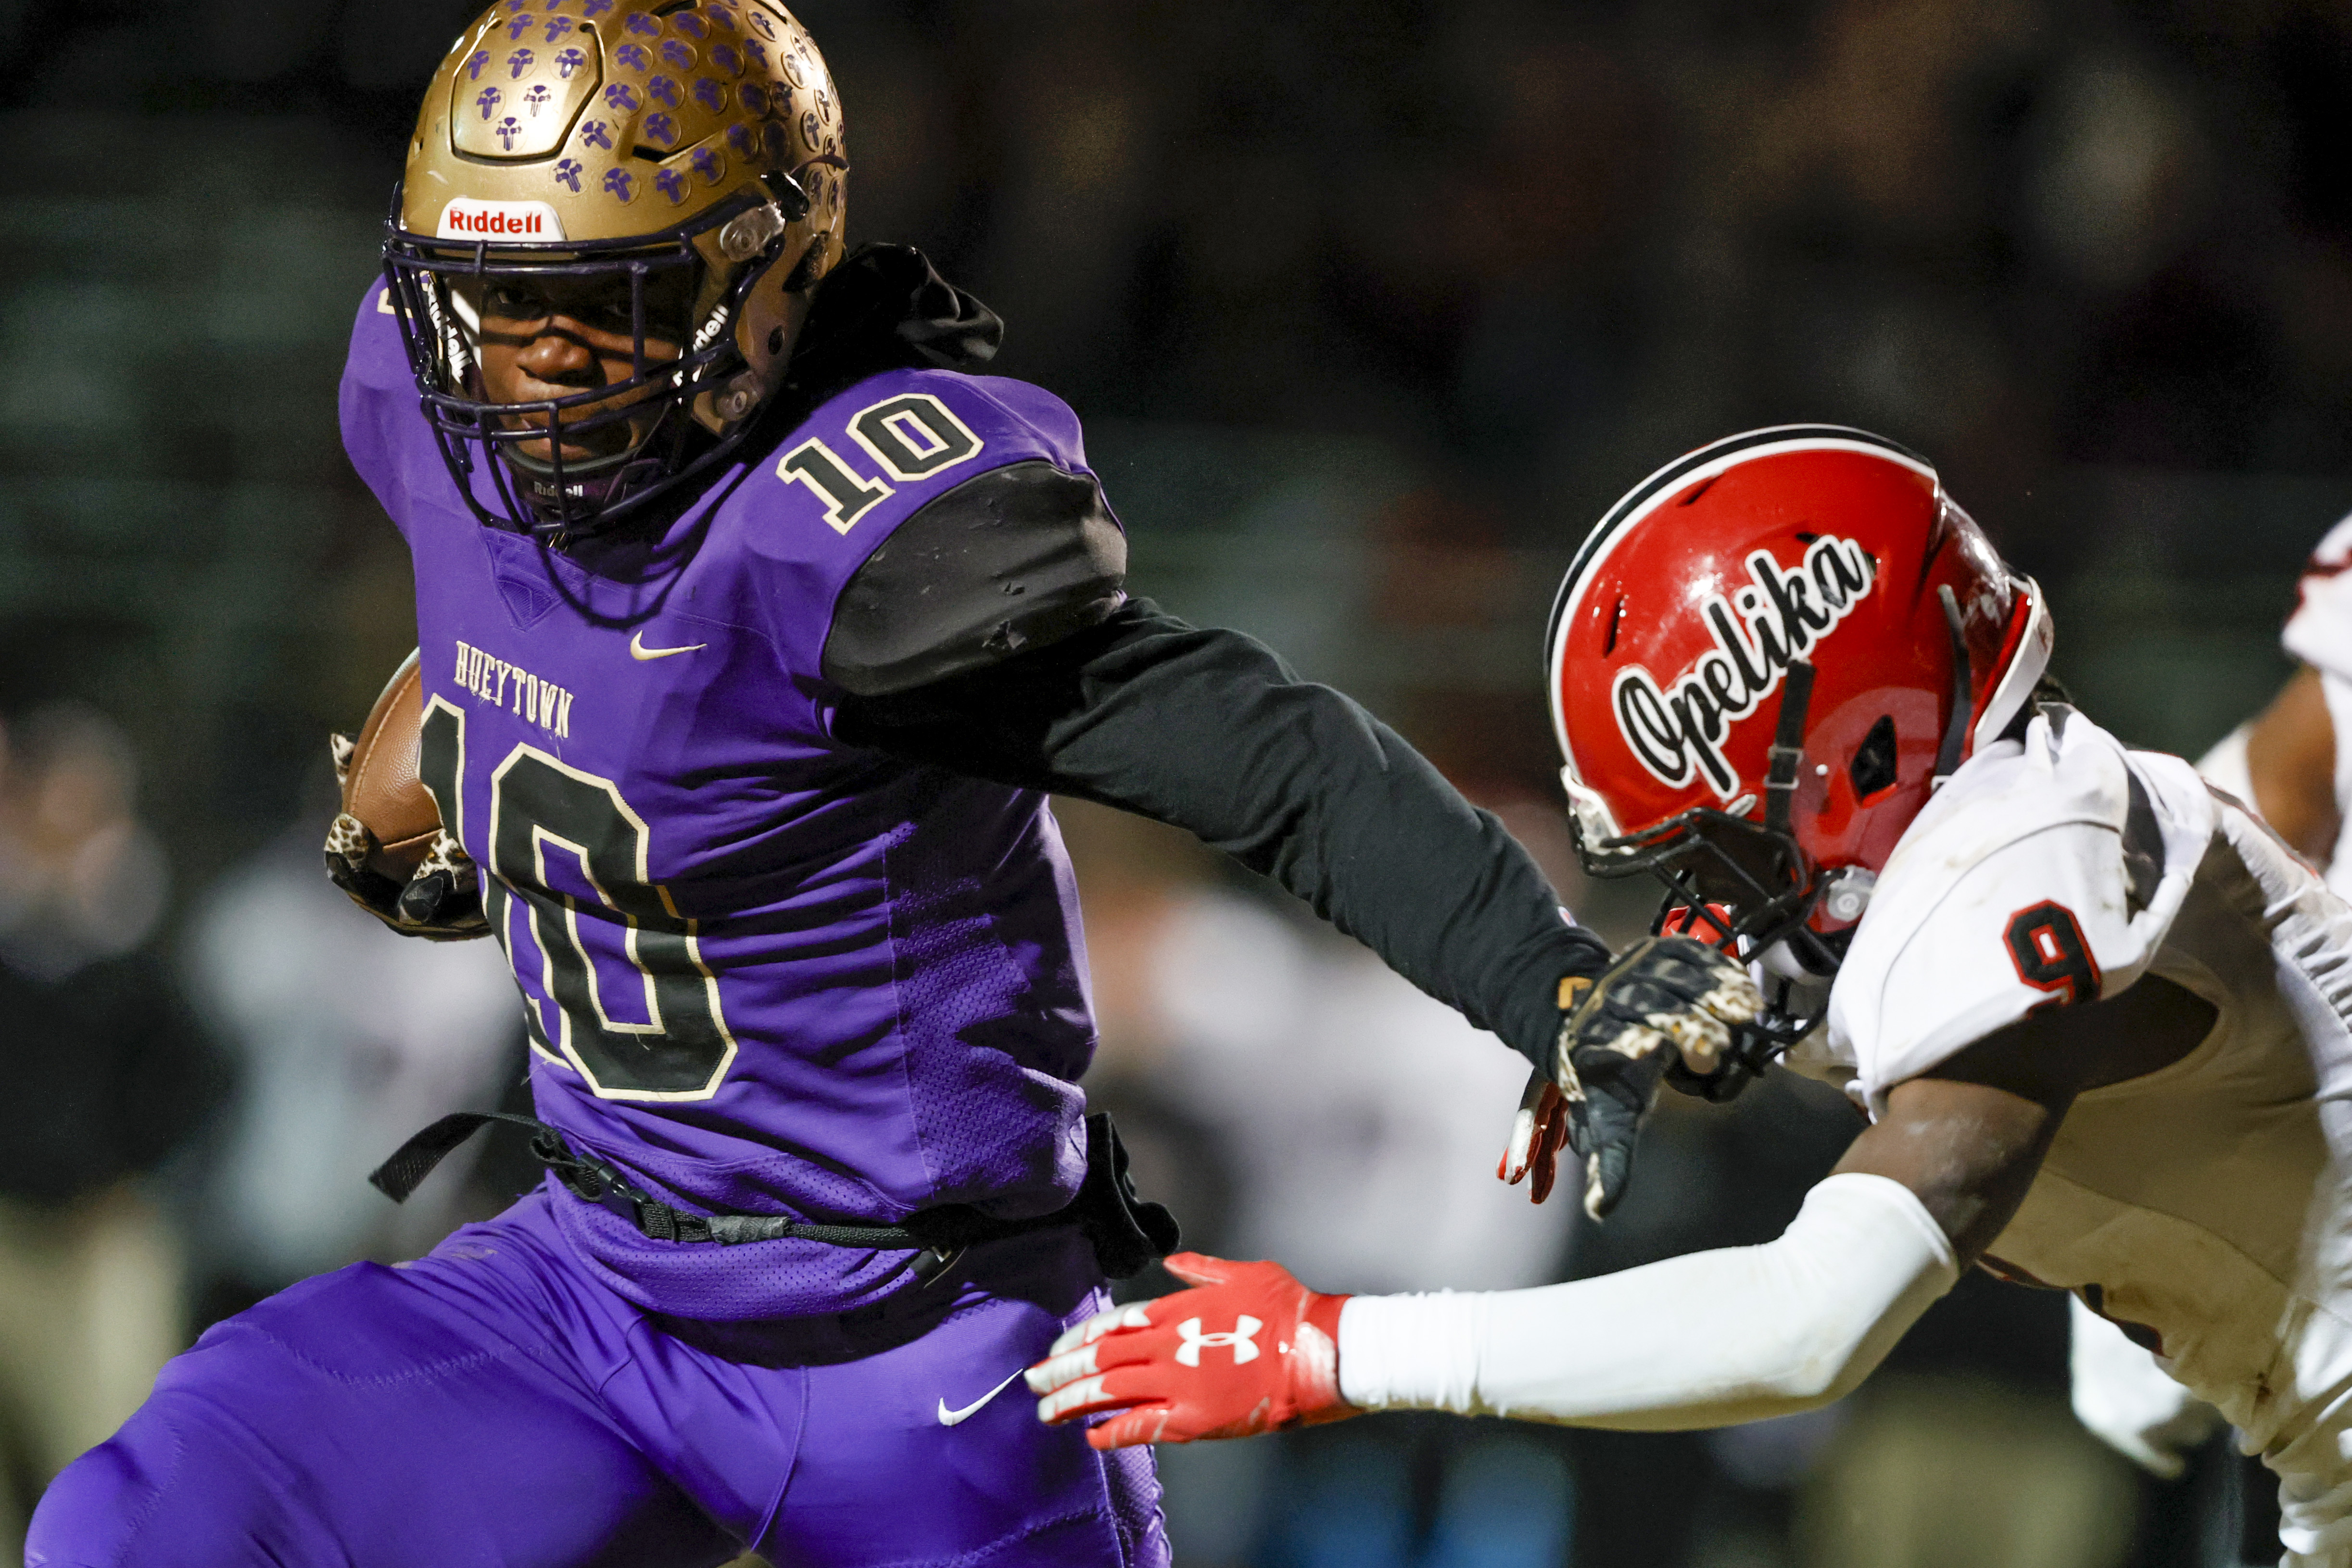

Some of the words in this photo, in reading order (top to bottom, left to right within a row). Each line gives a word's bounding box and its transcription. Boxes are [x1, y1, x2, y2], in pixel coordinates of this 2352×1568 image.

[450, 207, 542, 234] Riddell
[775, 392, 985, 535] 10
[453, 640, 574, 738] HUEYTOWN
[1612, 535, 1873, 798] Opelika
[417, 693, 738, 1101] 10
[2003, 898, 2100, 1019] 9
